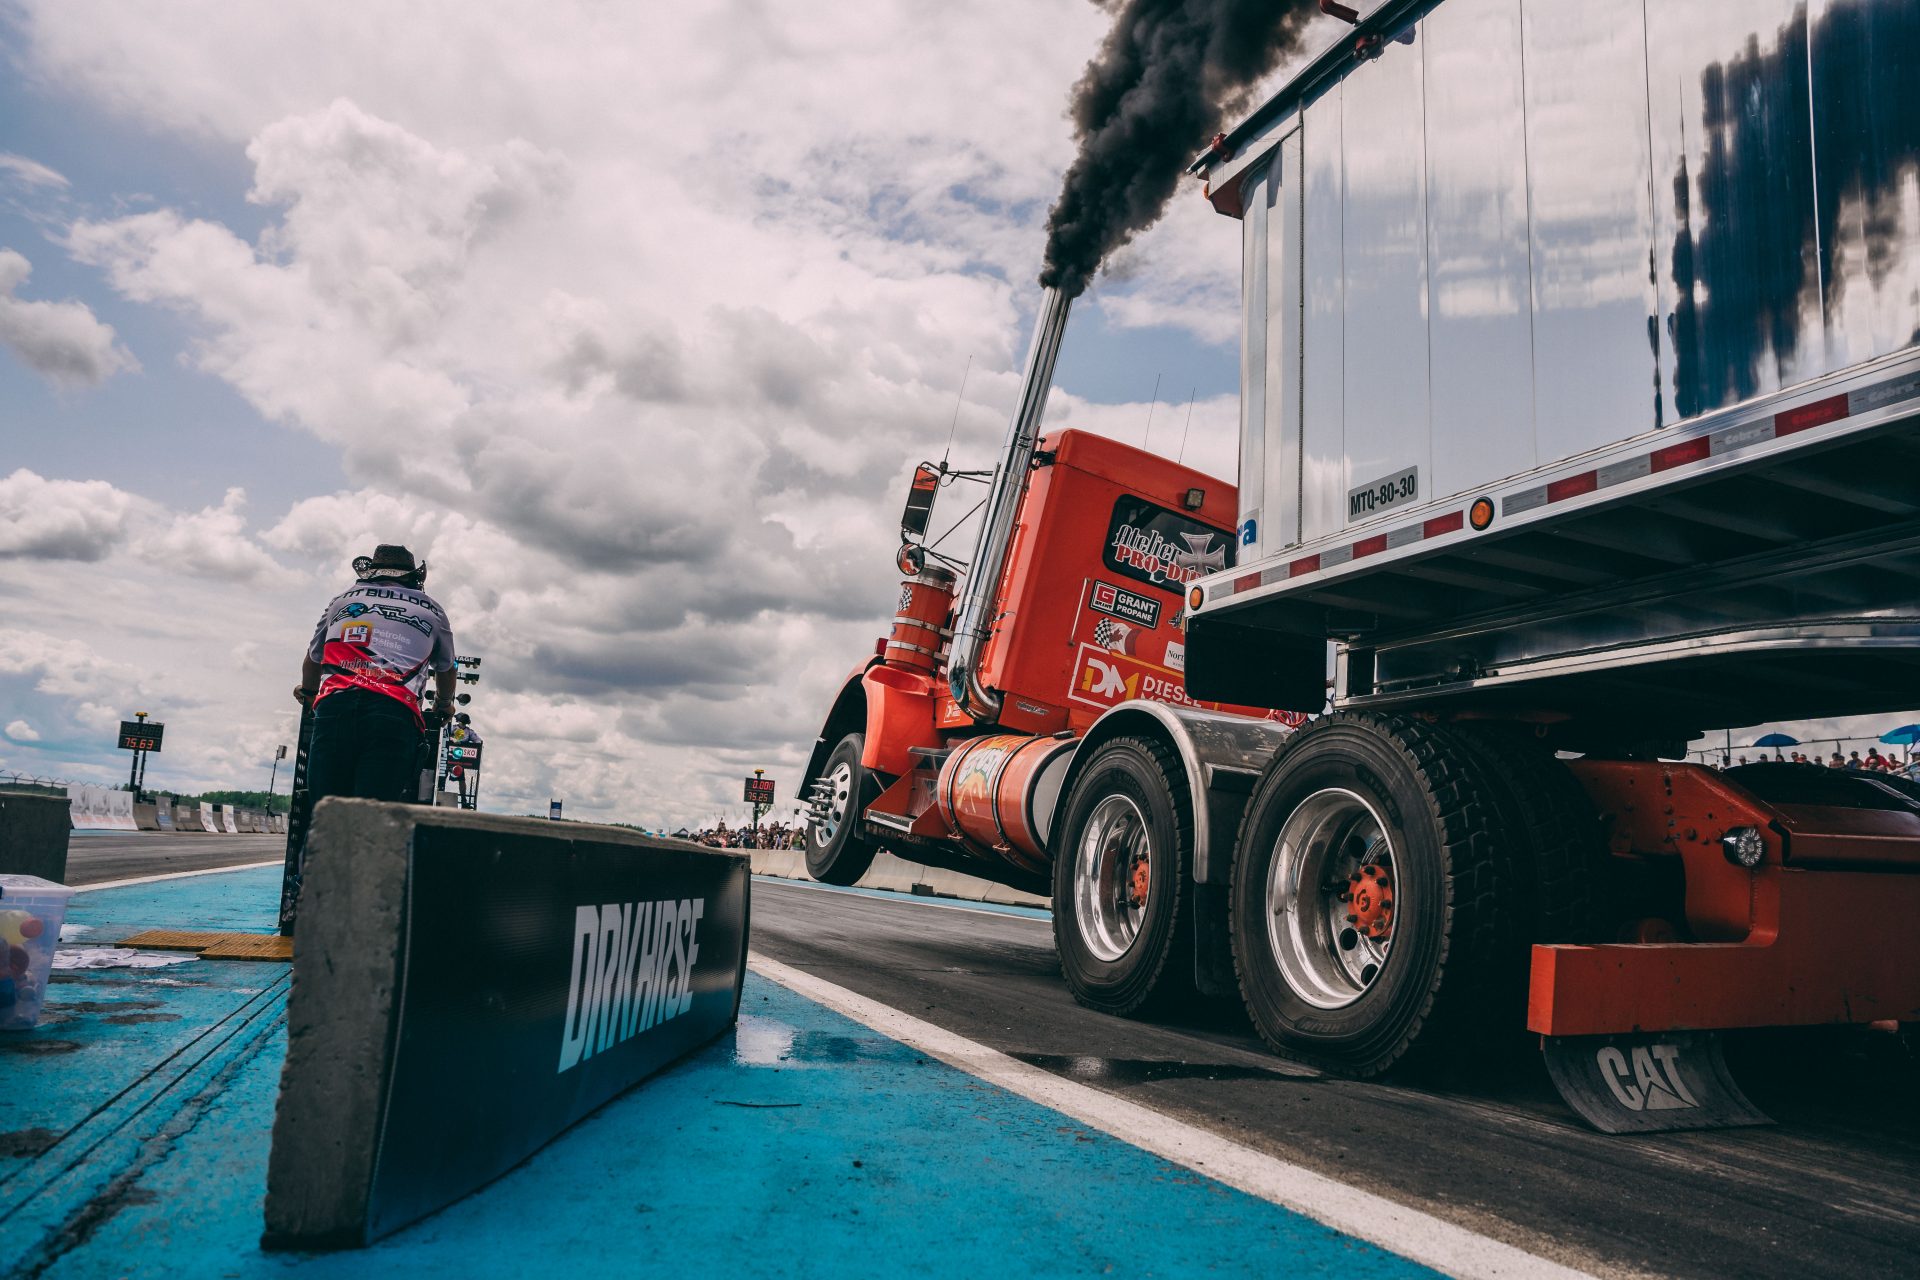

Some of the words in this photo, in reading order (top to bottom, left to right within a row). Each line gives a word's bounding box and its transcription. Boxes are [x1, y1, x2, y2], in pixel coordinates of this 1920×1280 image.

[1350, 474, 1415, 516] MTQ-80-30
[1117, 604, 1153, 622] PROPANE
[1118, 594, 1156, 614] GRANT
[367, 605, 433, 634] ATLAS
[455, 655, 474, 663] TAGE
[878, 827, 930, 846] KENWOR
[558, 898, 704, 1074] DRKHRSE
[1596, 1045, 1699, 1111] CAT
